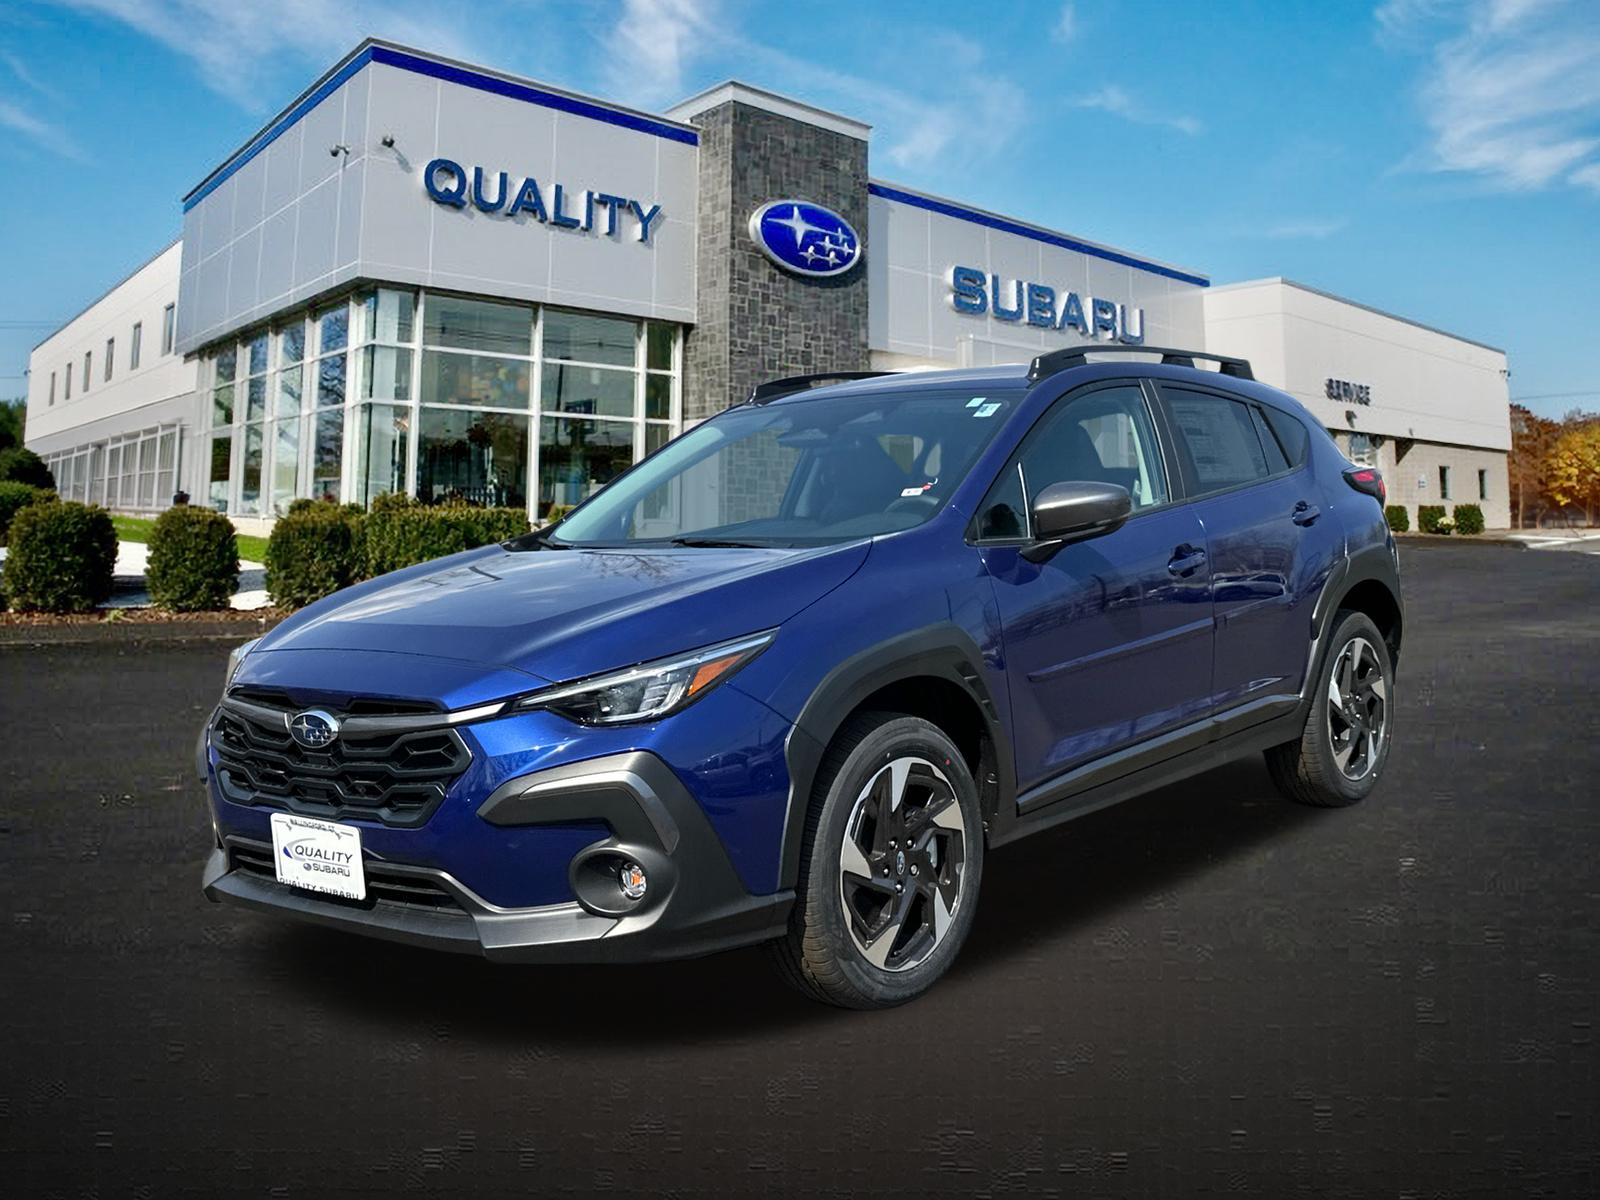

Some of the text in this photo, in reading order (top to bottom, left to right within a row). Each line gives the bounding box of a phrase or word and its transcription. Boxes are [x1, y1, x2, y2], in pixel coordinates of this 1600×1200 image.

[423, 158, 662, 243] QUALITY
[951, 265, 1145, 345] SUBARU
[1325, 378, 1371, 406] SERVICE
[294, 845, 353, 864] QUALITY
[312, 863, 351, 877] SUBARU
